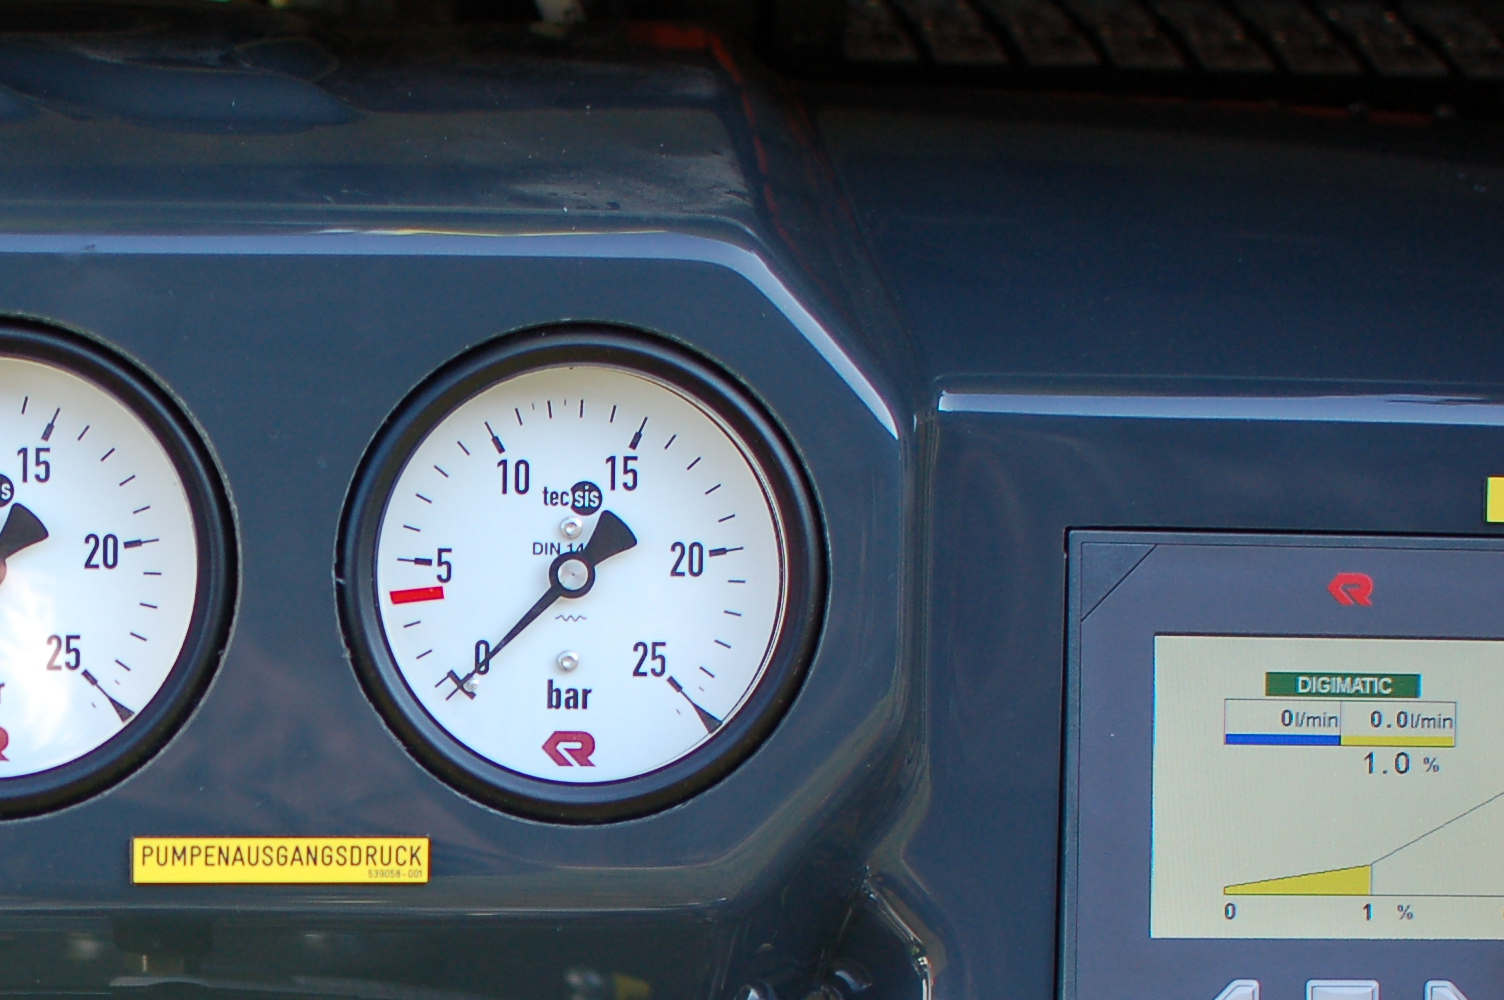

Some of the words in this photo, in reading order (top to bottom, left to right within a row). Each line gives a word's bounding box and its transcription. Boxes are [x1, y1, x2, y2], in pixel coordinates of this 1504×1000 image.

[16, 447, 51, 483] 15
[496, 459, 530, 495] 10
[605, 455, 638, 491] 15
[542, 485, 600, 508] tecsis
[83, 534, 118, 569] 20
[435, 548, 452, 583] 5
[532, 542, 561, 556] DIN
[670, 541, 703, 578] 20
[46, 635, 81, 671] 25
[474, 639, 491, 675] 0
[632, 641, 666, 677] 25
[546, 679, 593, 711] bar
[1297, 676, 1393, 694] DIGIMATIC
[1364, 751, 1410, 775] 1.0
[1423, 757, 1440, 773] %
[142, 845, 422, 867] PUMPENAUSGANGSDRUCK
[1224, 902, 1236, 920] 0
[1362, 903, 1372, 921] 1
[1397, 904, 1413, 920] %
